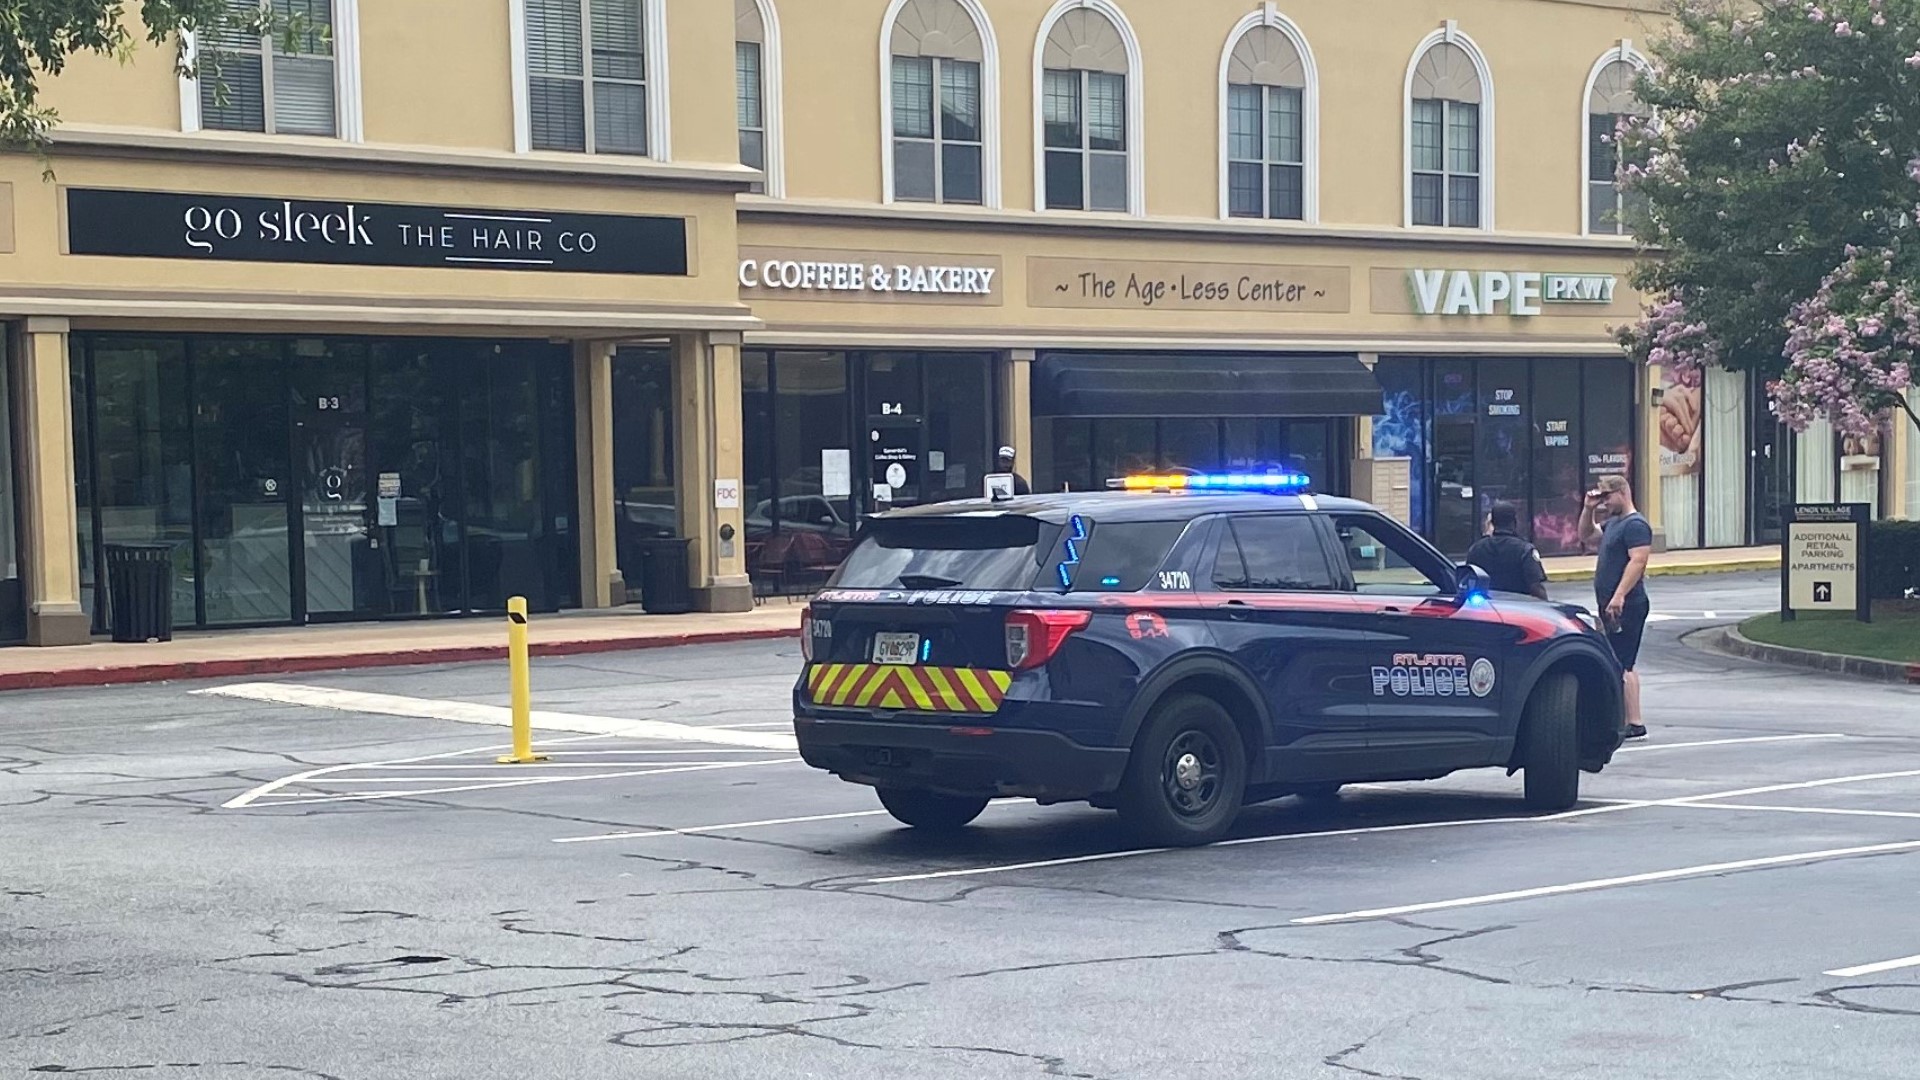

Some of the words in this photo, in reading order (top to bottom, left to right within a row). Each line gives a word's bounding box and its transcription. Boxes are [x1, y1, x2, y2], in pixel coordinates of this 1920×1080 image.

[184, 206, 242, 253] go
[258, 201, 374, 245] sleek
[398, 224, 454, 248] THE
[473, 228, 542, 250] HAIR
[558, 232, 596, 252] CO
[763, 260, 865, 290] COFFEE
[870, 264, 892, 291] &
[895, 264, 995, 294] BAKERY
[1078, 272, 1116, 298] The
[1237, 276, 1306, 301] Center
[1409, 269, 1541, 316] VAPE
[1547, 276, 1617, 300] PKWY
[1495, 389, 1514, 401] STOP
[882, 403, 902, 415] B-4
[1488, 404, 1520, 416] SMOKING
[1546, 420, 1568, 432] START
[1544, 435, 1569, 447] VAPING
[717, 488, 737, 499] FDC
[1820, 506, 1852, 514] VILLAGE
[1794, 533, 1852, 541] ADDITIONAL
[1806, 541, 1840, 550] RETAIL
[1801, 550, 1844, 558] PARKING
[1791, 563, 1855, 571] APARTMENTS
[1393, 653, 1466, 666] ATLANTA
[1371, 666, 1470, 696] POLICE
